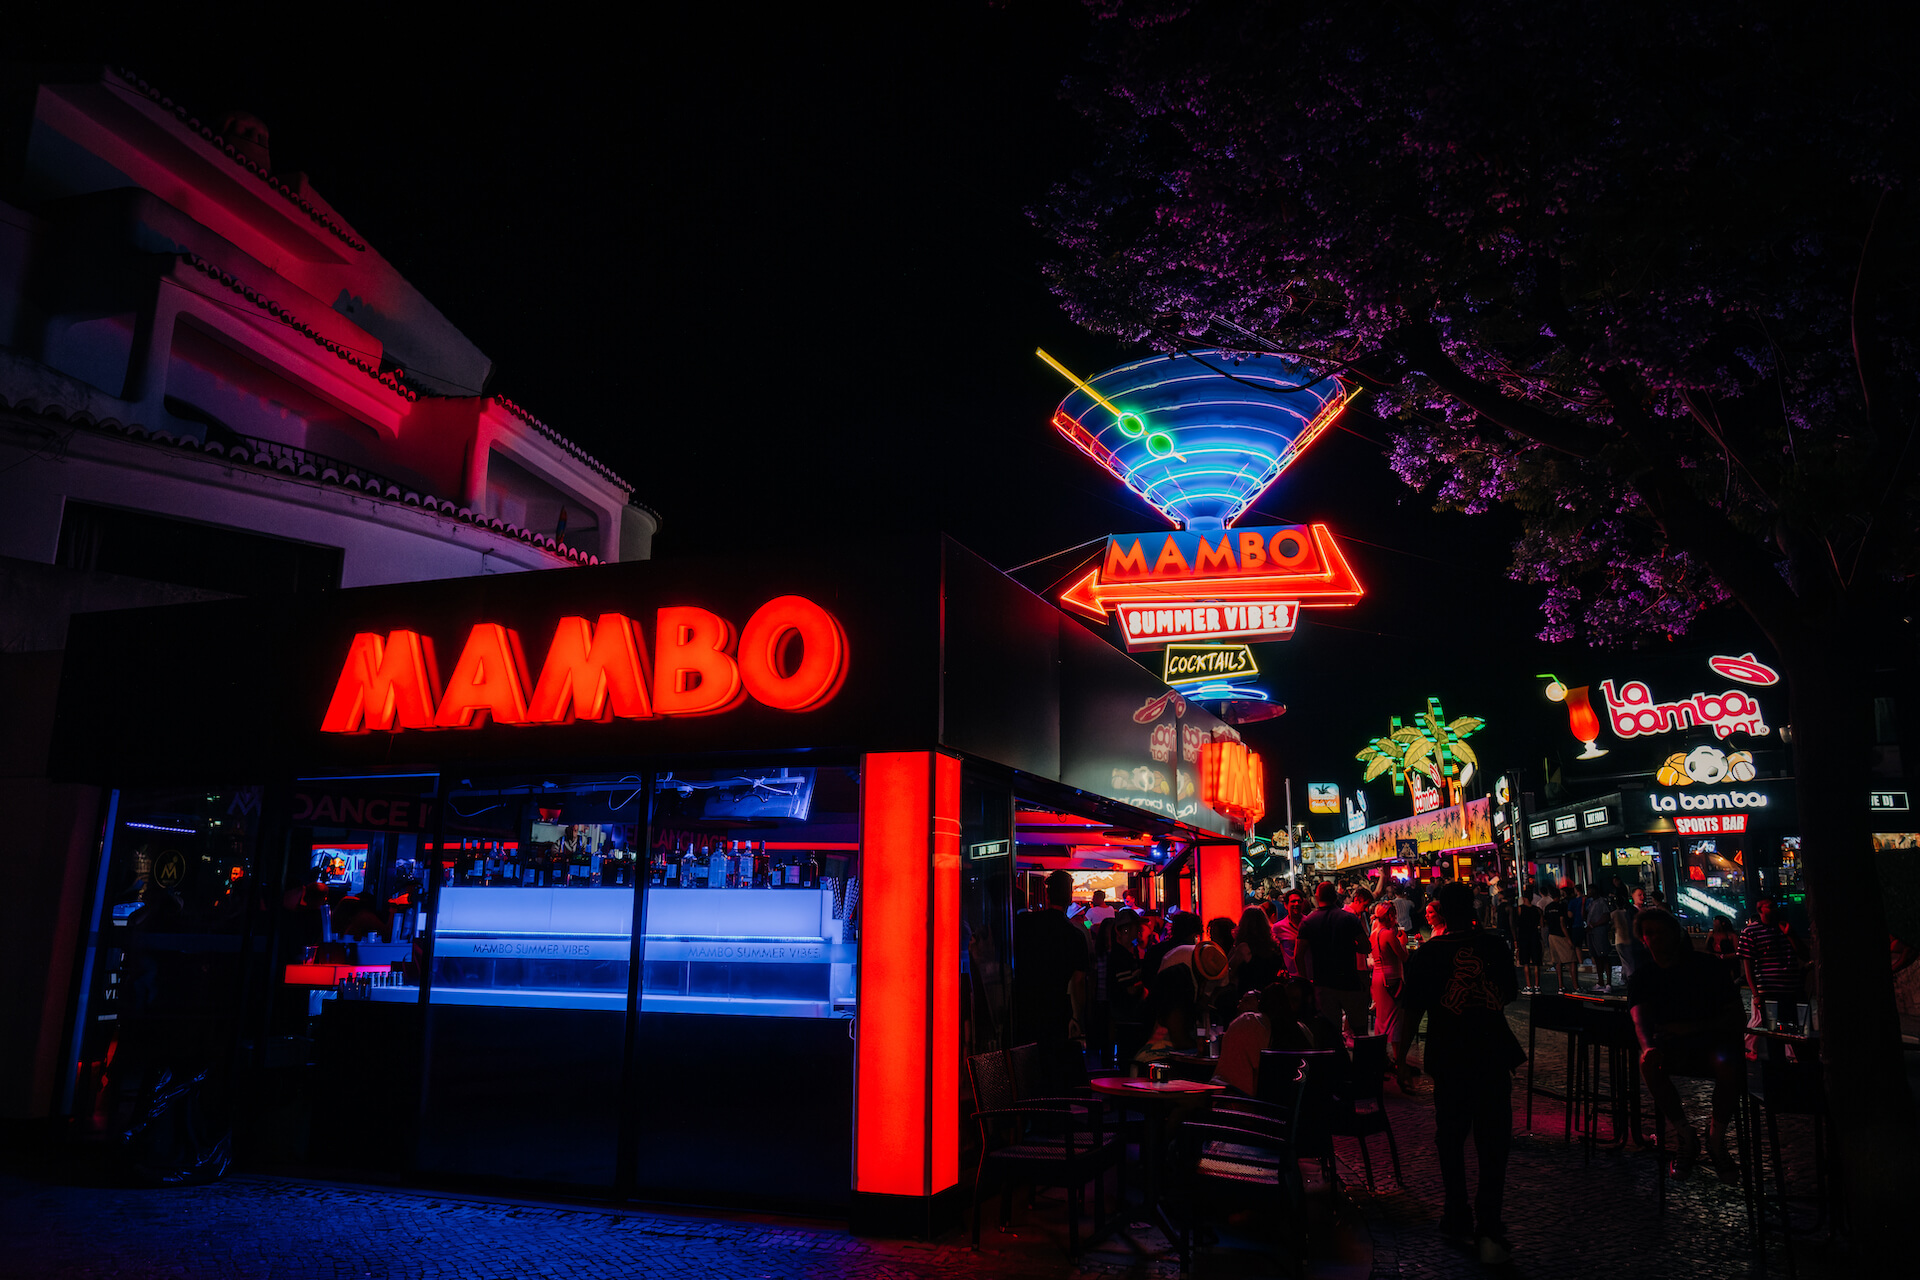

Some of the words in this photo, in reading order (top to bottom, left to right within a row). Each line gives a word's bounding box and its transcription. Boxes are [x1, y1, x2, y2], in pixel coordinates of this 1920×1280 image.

[1105, 529, 1310, 577] MAMBO
[1128, 608, 1220, 635] SUMMER
[1224, 605, 1290, 630] VIBES
[320, 594, 851, 734] MAMBO
[1168, 650, 1247, 674] COCKTAILS
[1609, 691, 1758, 738] bamba
[292, 792, 410, 827] DANCE
[1679, 790, 1769, 811] bamba
[1676, 816, 1719, 834] SPORTS
[1722, 815, 1745, 832] BAR
[473, 944, 513, 954] MAMBO
[516, 944, 559, 955] SUMMER
[562, 945, 590, 955] VIBES
[688, 947, 734, 958] MAMBO
[737, 948, 785, 959] SUMMER
